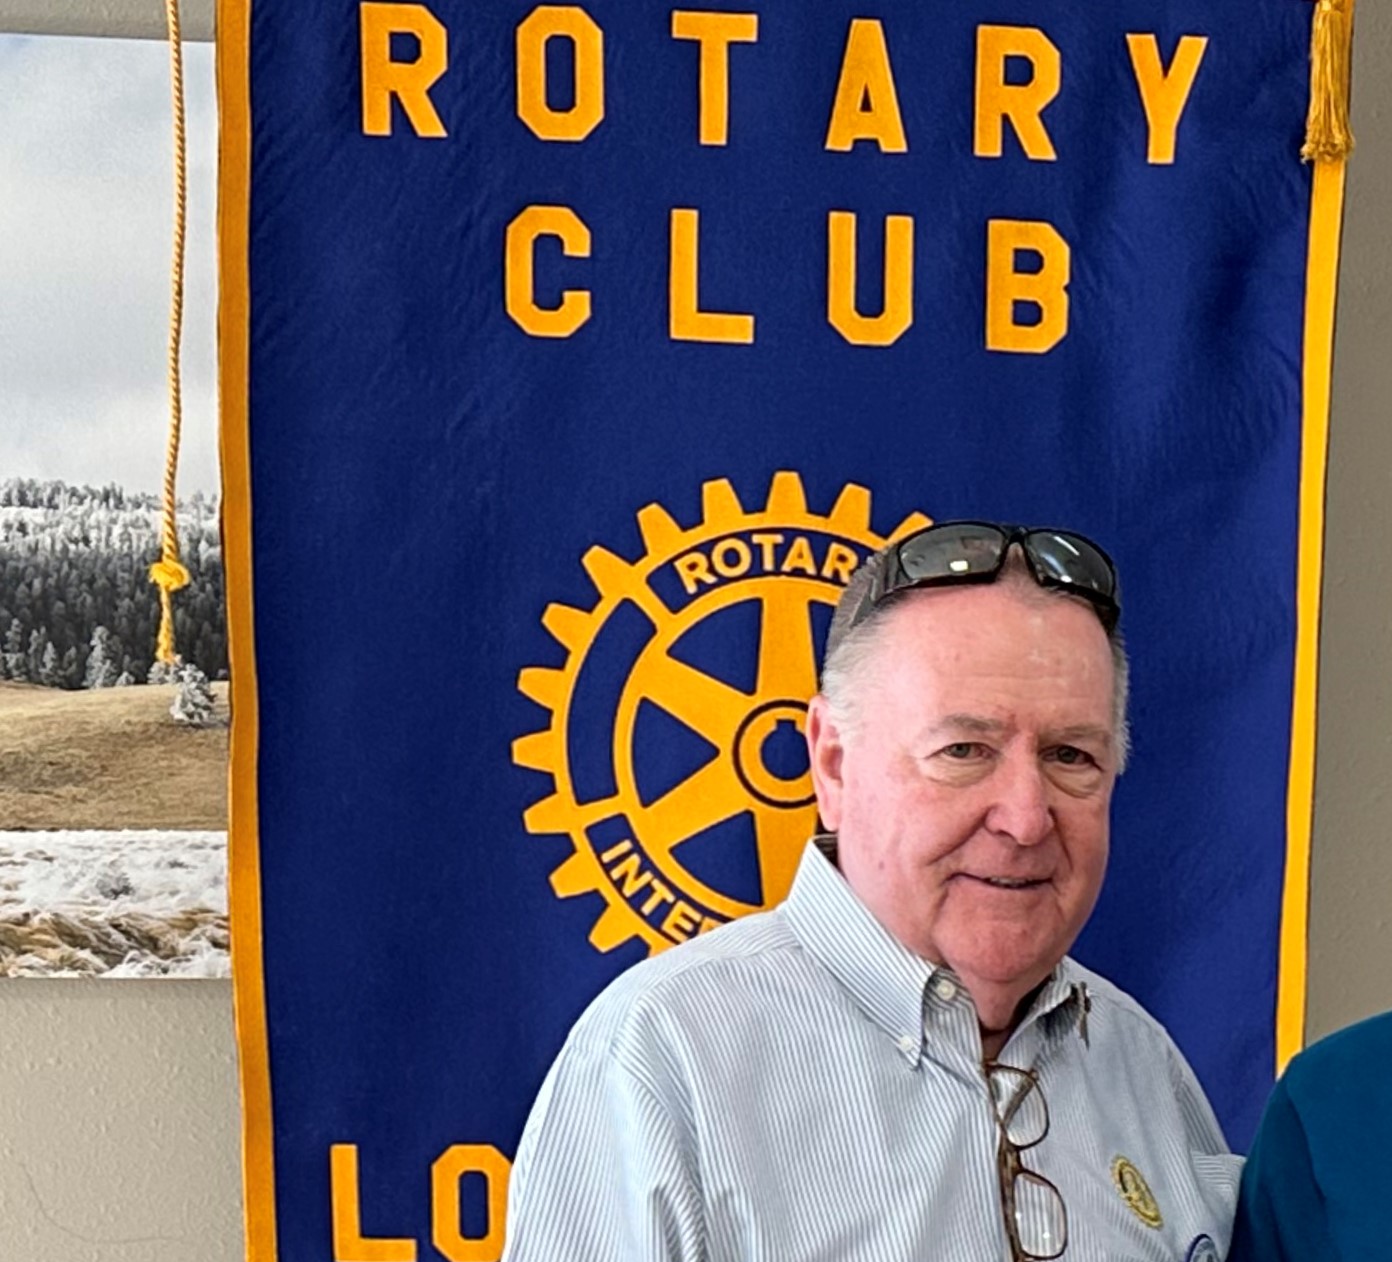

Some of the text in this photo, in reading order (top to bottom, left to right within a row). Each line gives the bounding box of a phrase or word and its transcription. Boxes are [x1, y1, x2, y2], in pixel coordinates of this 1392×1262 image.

[359, 1, 1208, 164] ROTARY
[505, 206, 1071, 353] CLUB
[601, 839, 722, 944] INTE
